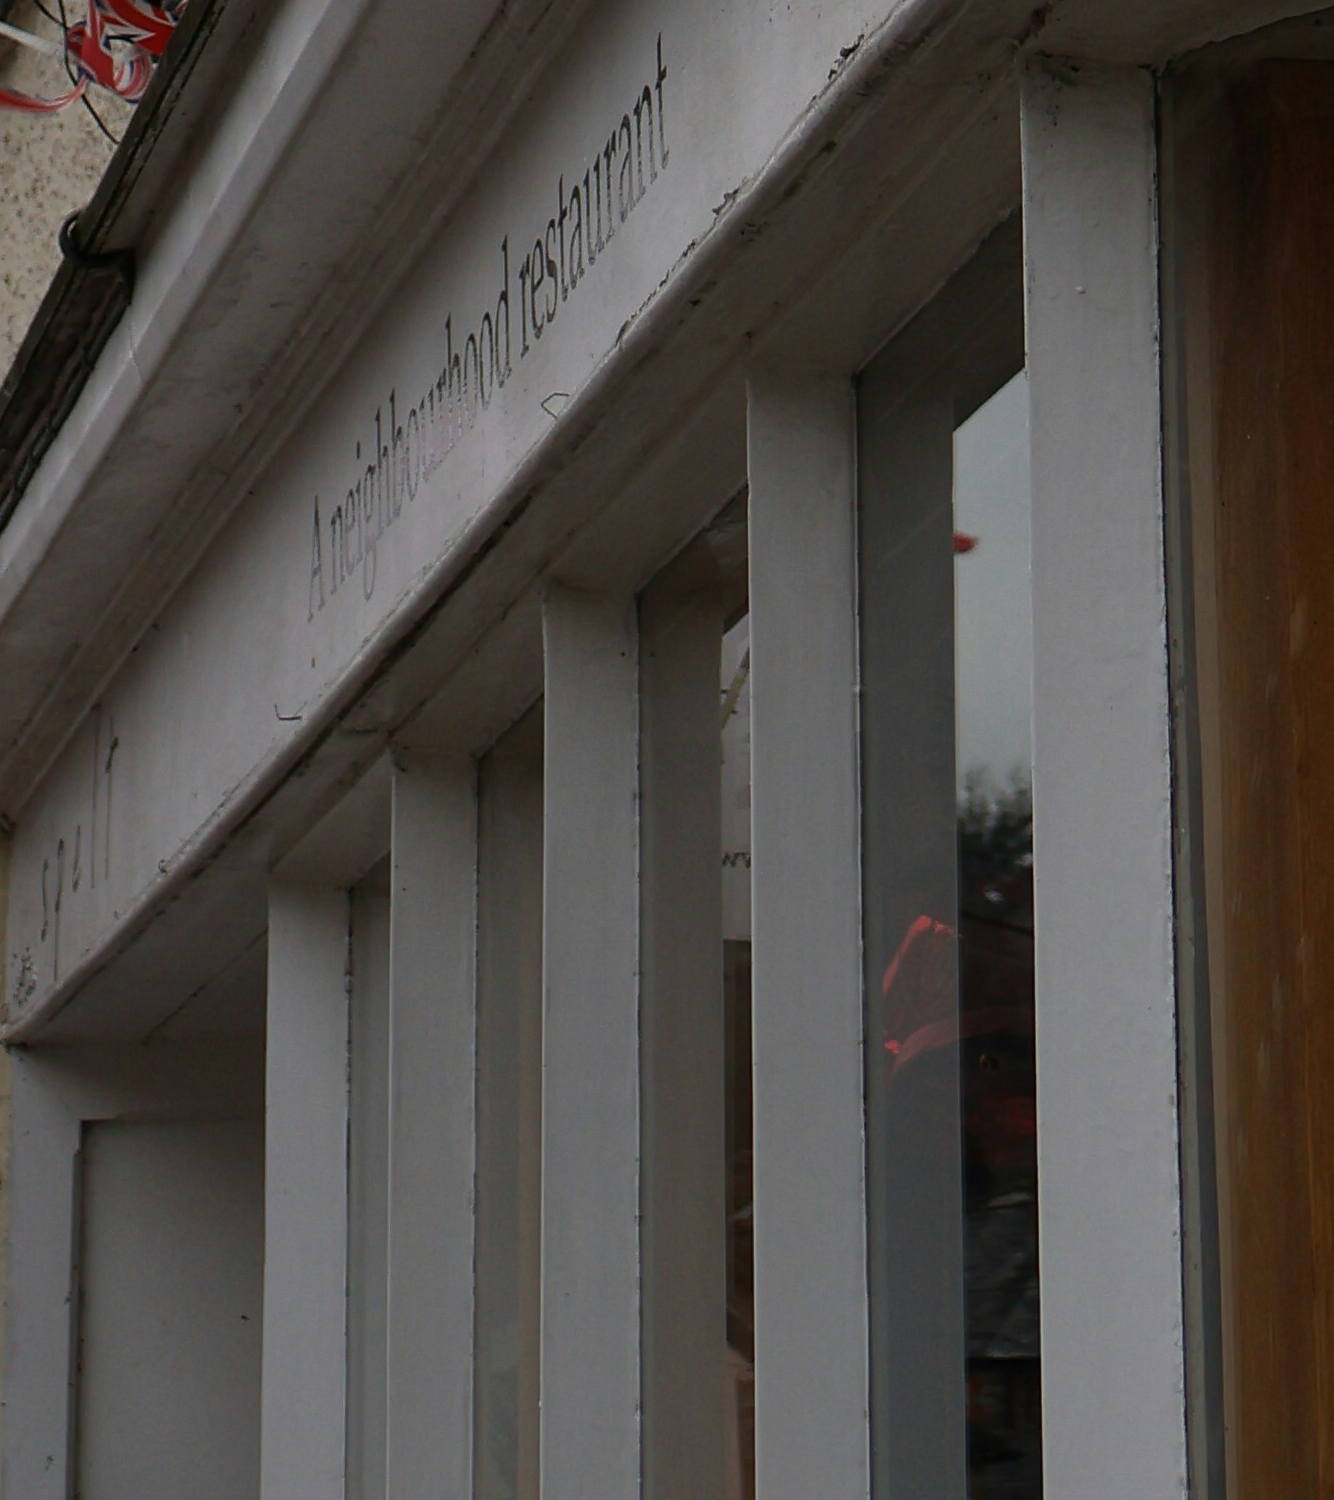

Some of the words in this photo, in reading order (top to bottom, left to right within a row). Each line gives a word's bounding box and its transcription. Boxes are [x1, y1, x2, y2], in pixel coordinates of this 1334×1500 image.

[306, 494, 324, 622] A
[330, 235, 512, 601] neighbourhood
[518, 31, 670, 359] restaurant
